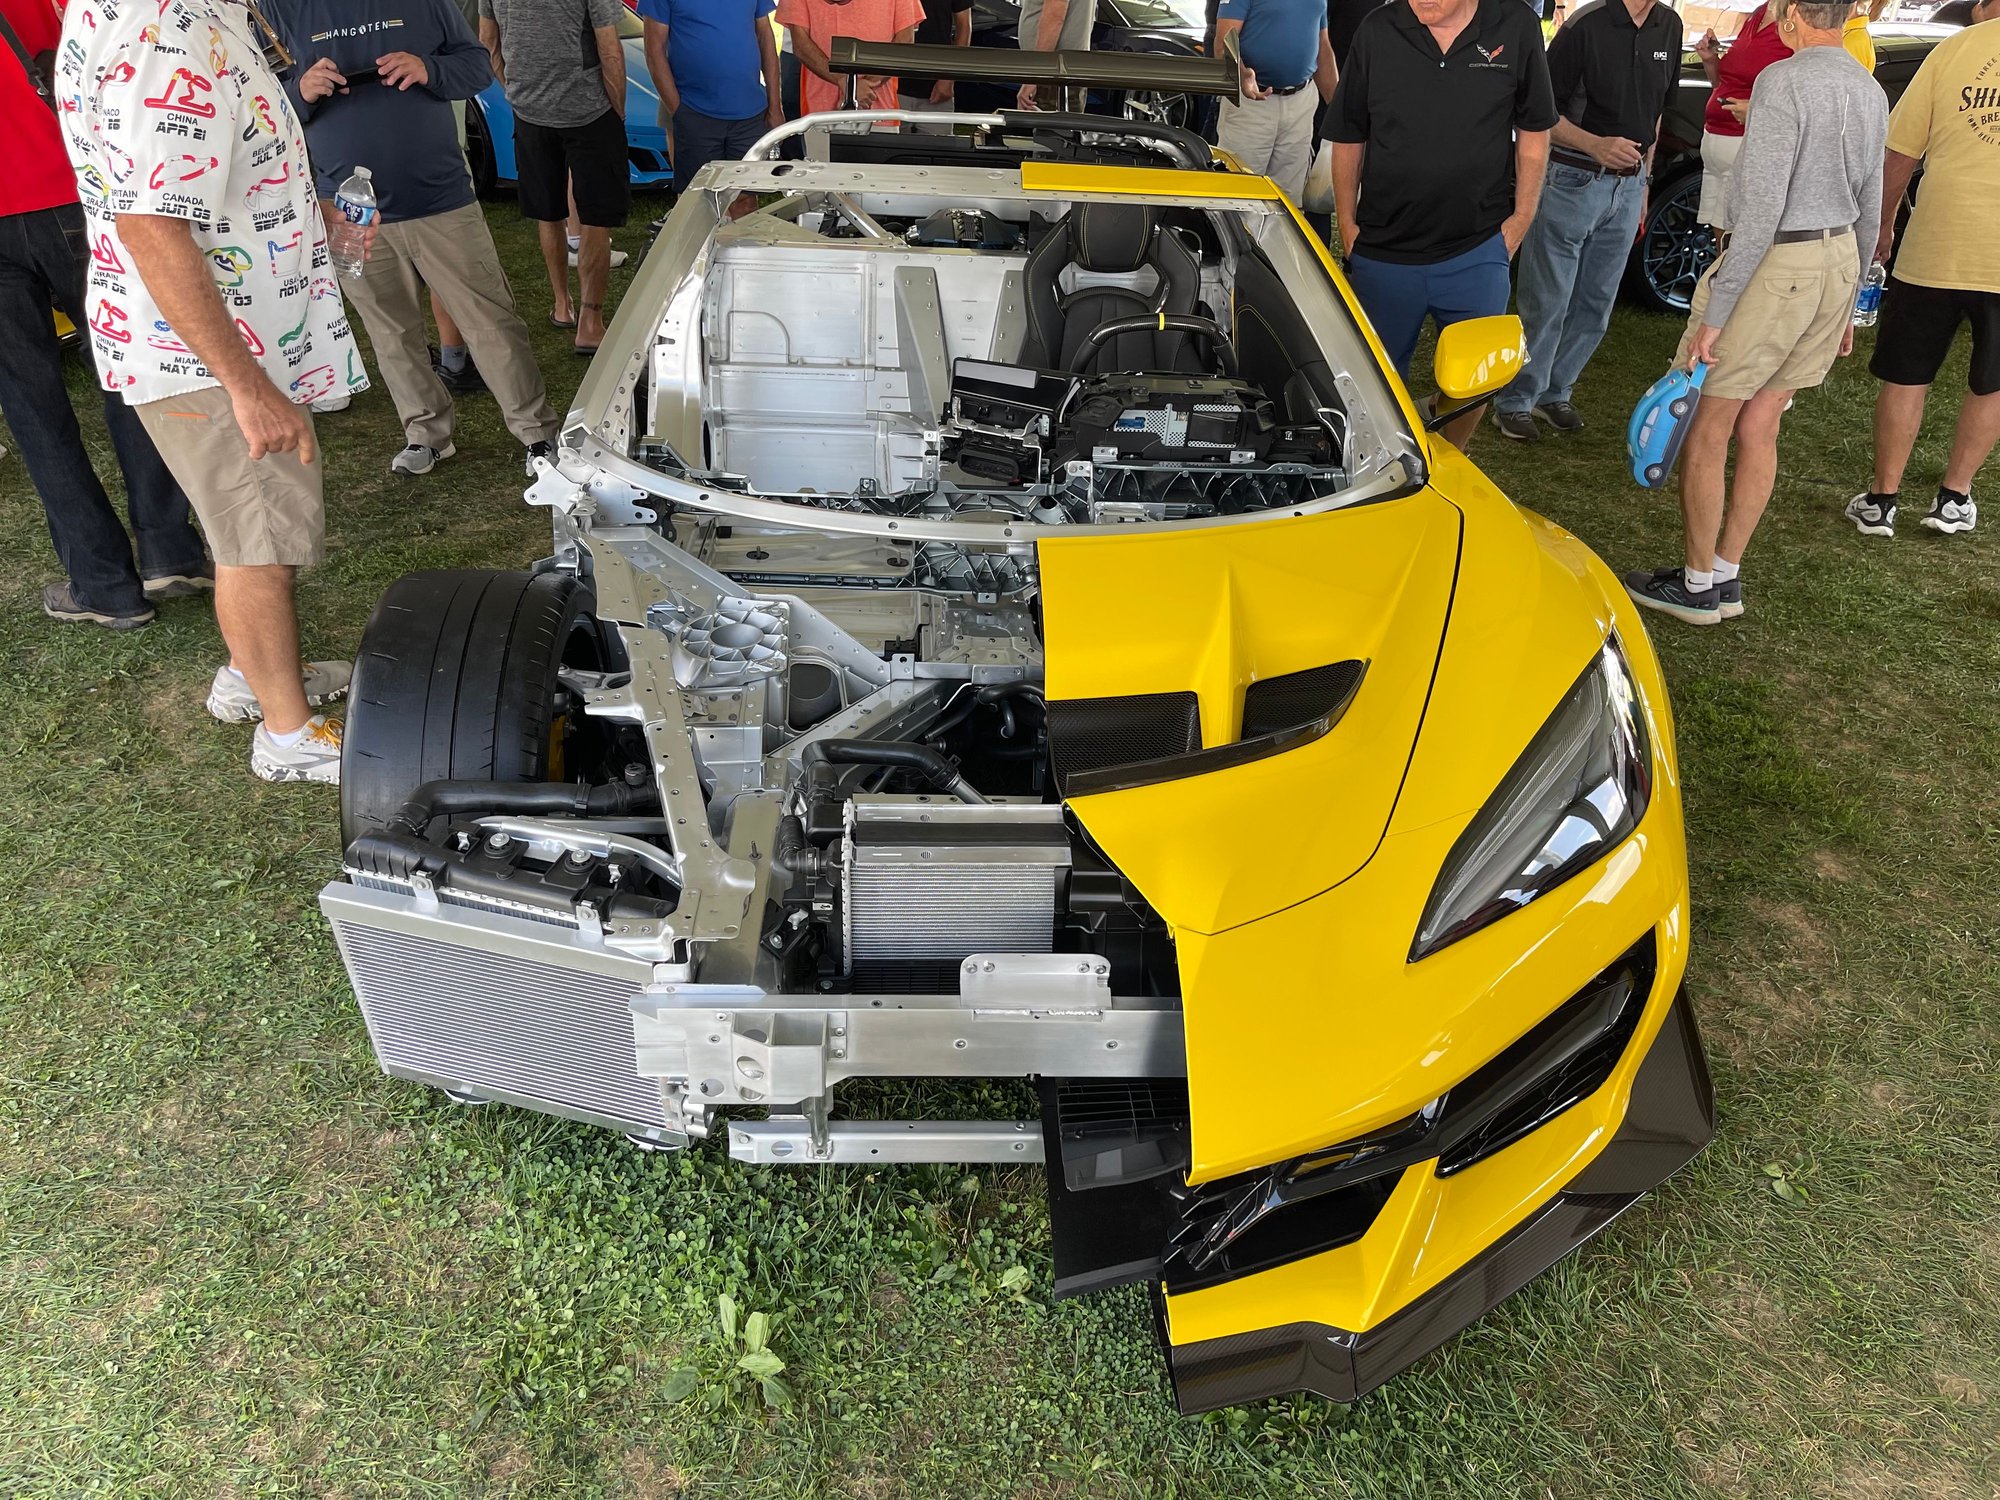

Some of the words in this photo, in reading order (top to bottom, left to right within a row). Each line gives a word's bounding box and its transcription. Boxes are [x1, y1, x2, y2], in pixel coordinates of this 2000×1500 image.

[1975, 57, 1998, 81] THREE
[1959, 86, 2000, 112] SHI
[166, 113, 199, 126] CHINA
[155, 121, 189, 137] APR
[193, 127, 207, 141] 21
[252, 136, 280, 157] BELGIUM
[252, 151, 273, 168] JUL
[86, 196, 111, 210] BRAZIL
[162, 192, 204, 207] CANADA
[155, 202, 188, 217] JUN
[254, 217, 280, 233] SEP
[279, 285, 299, 299] NOV
[233, 295, 252, 307] 03
[96, 334, 117, 349] CHINA
[159, 362, 190, 376] MAY
[348, 380, 369, 395] EMILIA
